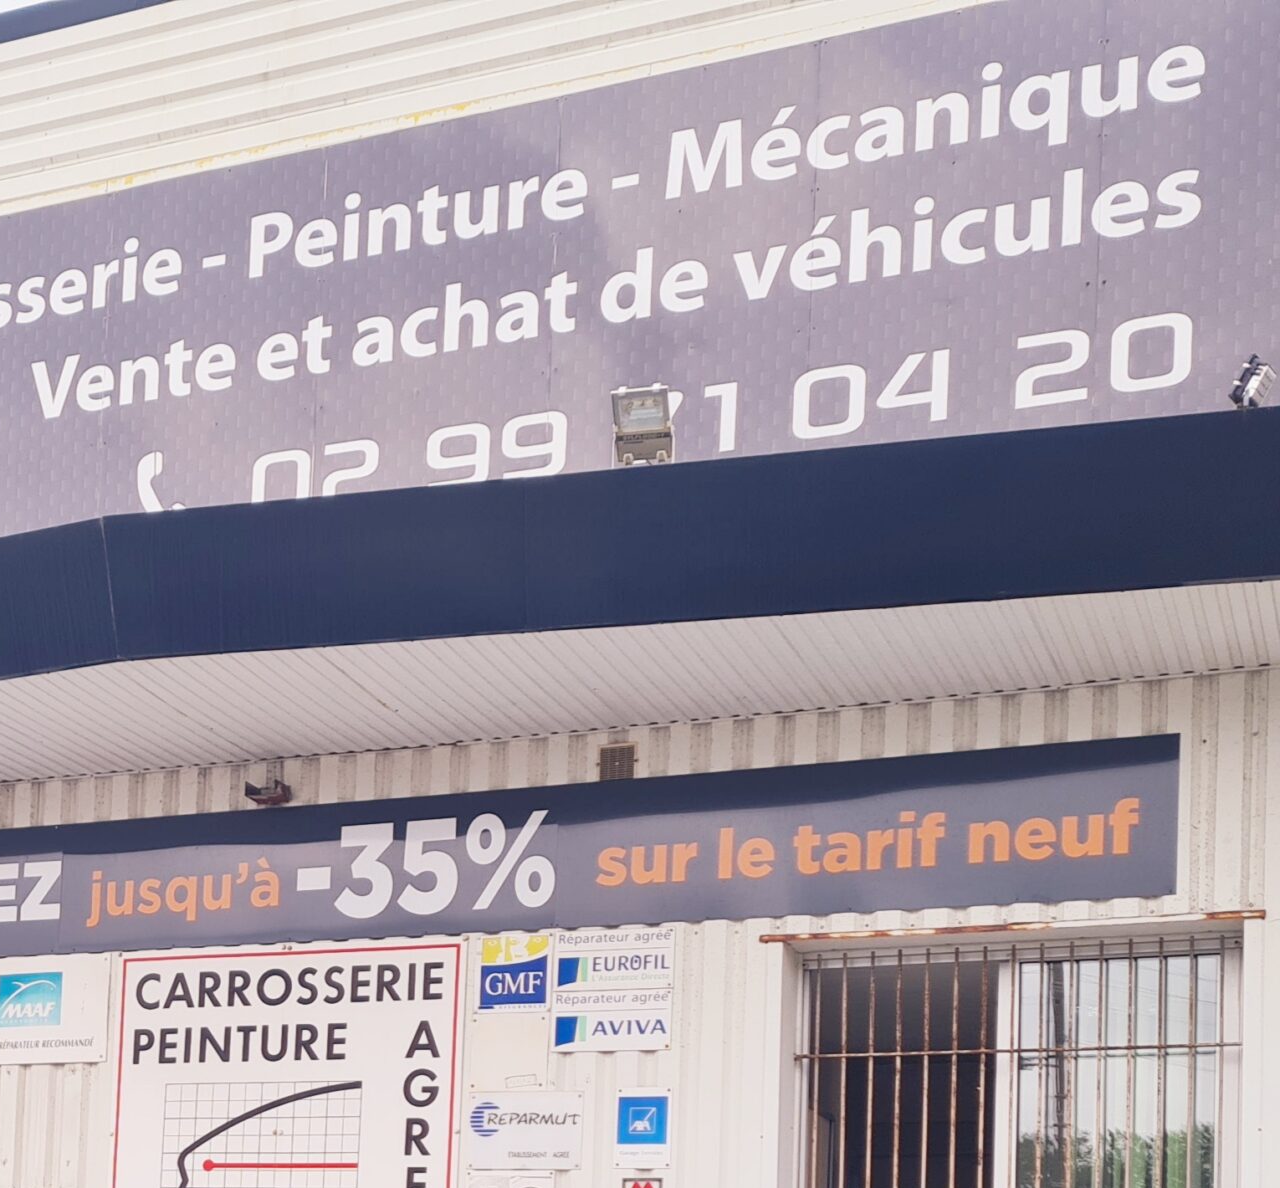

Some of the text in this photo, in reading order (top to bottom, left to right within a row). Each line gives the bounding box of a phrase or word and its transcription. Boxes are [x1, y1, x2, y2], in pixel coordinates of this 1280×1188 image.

[248, 167, 588, 279] Peinture
[665, 44, 1207, 200] Mécanique
[31, 167, 1203, 420] Vente et achat de véhicules
[251, 439, 380, 504] 02
[426, 410, 568, 486] 99
[792, 348, 951, 441] 04
[1014, 312, 1193, 410] 20
[87, 858, 281, 928] jusqu'à
[296, 810, 556, 920] -35%
[597, 837, 699, 888] sur
[718, 827, 774, 880] le
[794, 810, 949, 873] tarif
[968, 797, 1140, 865] neuf
[558, 931, 629, 946] Réparateur
[592, 954, 670, 972] EUROFIL
[135, 962, 445, 1010] CARROSSERIE
[484, 971, 544, 996] GMF
[1, 1002, 56, 1019] MAAF
[556, 991, 627, 1007] Réparateur
[591, 1019, 667, 1036] AVIVA
[132, 1023, 348, 1065] PEINTURE
[487, 1112, 581, 1126] REPARMUT
